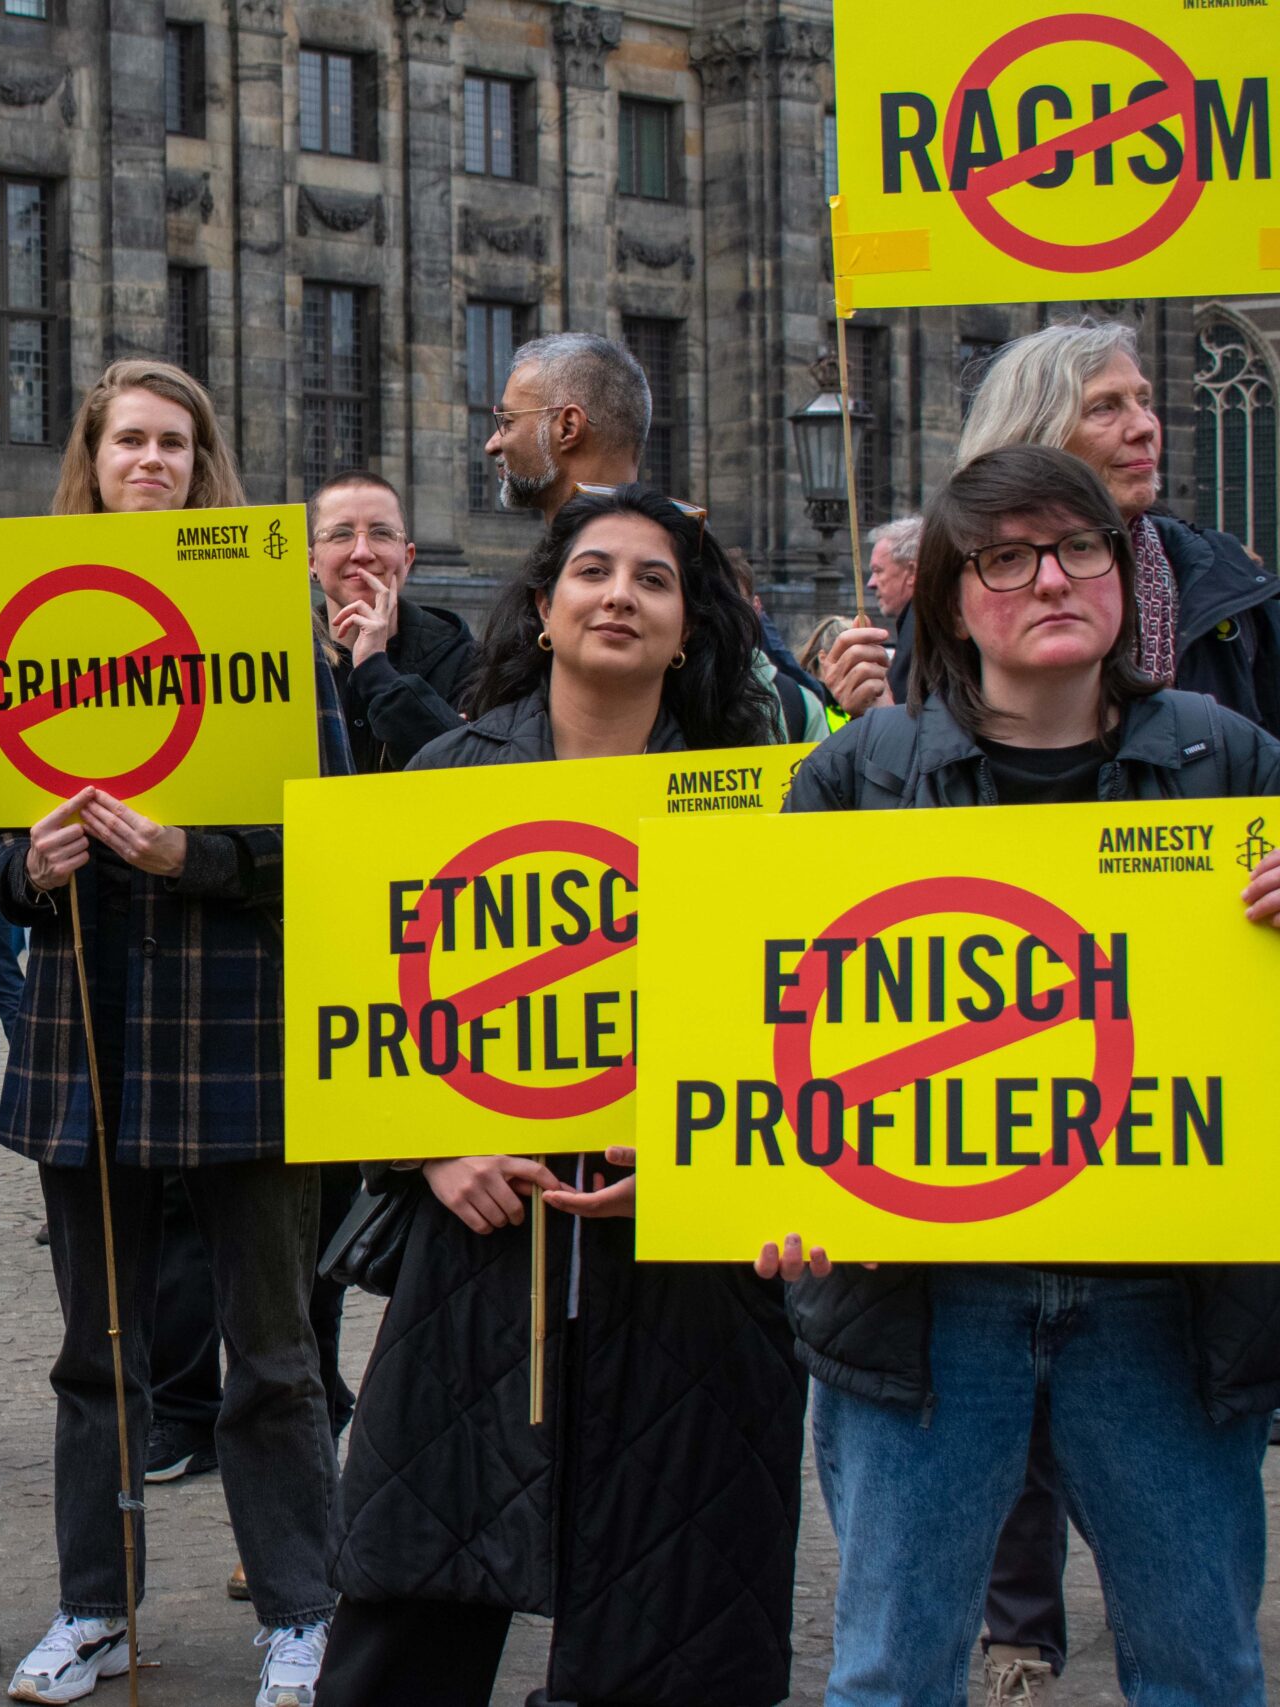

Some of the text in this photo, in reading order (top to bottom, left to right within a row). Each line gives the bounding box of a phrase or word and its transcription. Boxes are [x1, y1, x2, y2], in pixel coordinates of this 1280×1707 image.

[880, 77, 1272, 194] RACISM
[176, 525, 249, 548] AMNESTY
[177, 547, 250, 562] INTERNATIONAL
[667, 767, 763, 796] AMNESTY
[667, 794, 763, 813] INTERNATIONAL
[1099, 825, 1214, 853] AMNESTY
[1099, 856, 1214, 874] INTERNATIONAL
[389, 867, 638, 954] ETNISC
[764, 932, 1129, 1025] ETNISCH
[318, 990, 637, 1081] PROFILE
[675, 1076, 1224, 1168] PROFILEREN
